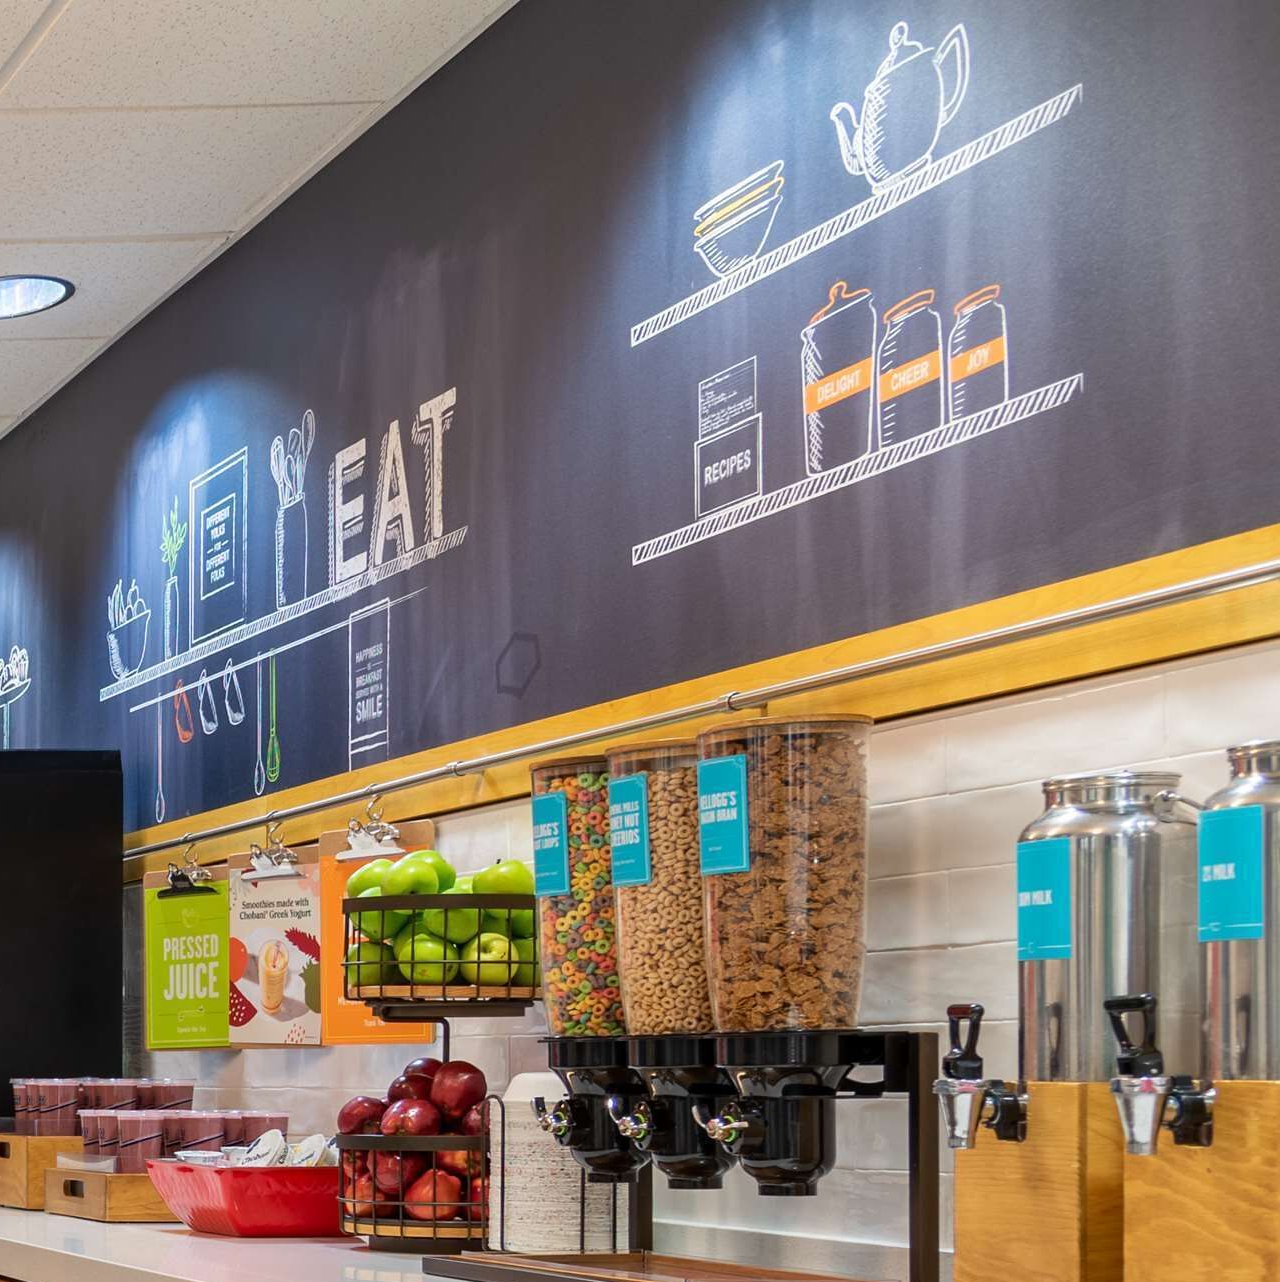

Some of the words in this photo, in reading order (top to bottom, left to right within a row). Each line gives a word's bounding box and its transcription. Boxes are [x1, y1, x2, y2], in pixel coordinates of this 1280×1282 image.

[966, 346, 990, 372] JOY
[816, 369, 862, 404] DELIGHT
[891, 361, 930, 392] CHEER
[704, 449, 751, 487] RECIPES
[327, 386, 457, 588] EAT
[206, 505, 231, 531] DIFFERENT
[206, 548, 230, 573] DIFFERENT
[210, 566, 225, 584] FOLKS
[355, 642, 383, 664] HAPPINESS
[355, 668, 383, 688] BREAKFAST
[355, 694, 383, 724] SMILE
[242, 900, 275, 909] Smoothies
[276, 899, 293, 907] made
[295, 897, 309, 906] with
[269, 910, 289, 919] Greek
[290, 910, 311, 920] Yogurt
[163, 933, 219, 961] PRESSED
[163, 961, 219, 1001] JUICE
